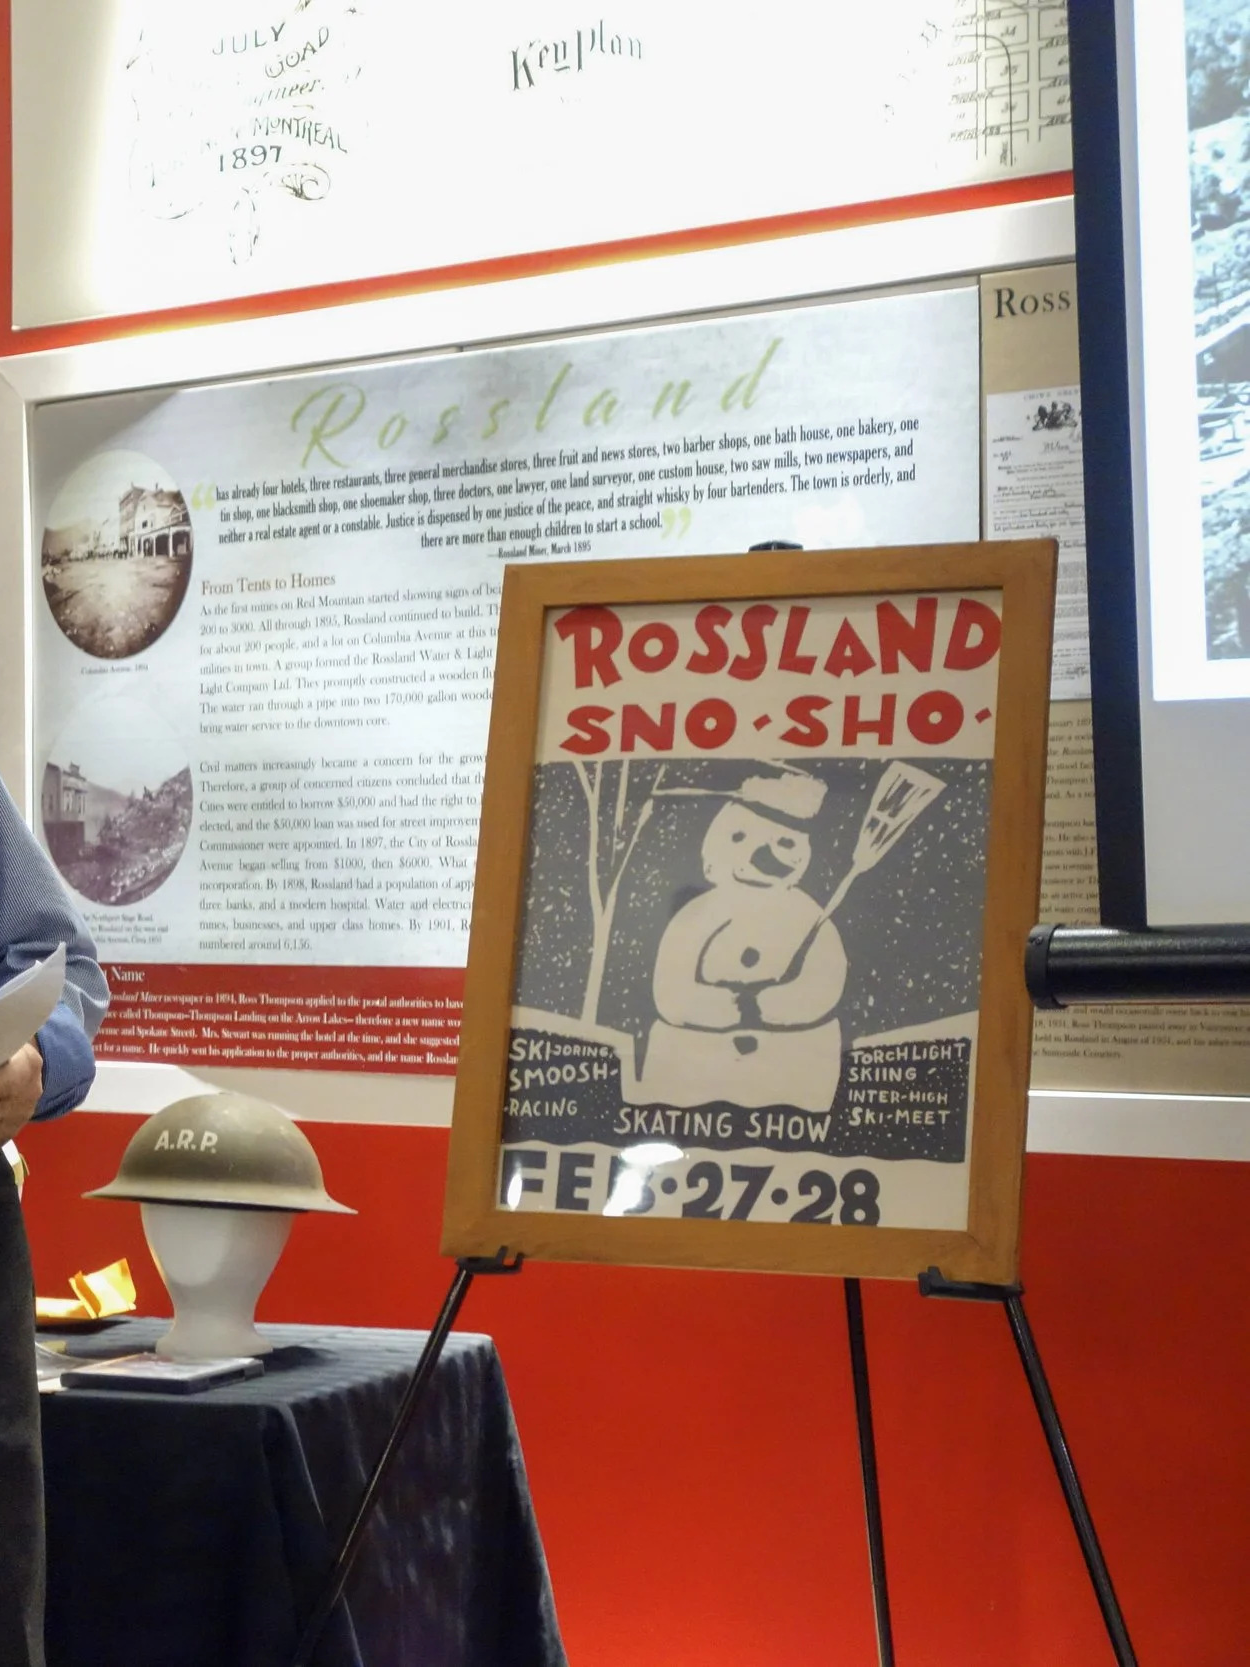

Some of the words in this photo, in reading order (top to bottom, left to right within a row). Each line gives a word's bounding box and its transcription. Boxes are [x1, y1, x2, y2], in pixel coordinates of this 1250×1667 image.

[212, 22, 286, 55] JULY
[253, 116, 347, 153] MONTREAL
[219, 145, 282, 172] 1897
[291, 338, 782, 469] Rossland
[215, 483, 229, 501] has
[230, 480, 260, 504] already
[261, 478, 279, 497] four
[280, 475, 308, 497] hotels,
[309, 473, 331, 492] three
[332, 469, 382, 492] restaurants,
[383, 465, 406, 485] three
[407, 462, 440, 487] general
[441, 456, 498, 479] merchandise
[499, 455, 530, 475] stores,
[532, 450, 557, 470] three
[558, 448, 579, 467] fruit
[580, 446, 599, 465] and
[600, 448, 625, 463] news
[627, 442, 660, 462] stores,
[661, 440, 681, 457] two
[682, 434, 715, 455] barber
[717, 431, 751, 456] shops,
[752, 434, 772, 448] one
[773, 426, 797, 446] bath
[799, 423, 833, 445] house,
[835, 426, 855, 440] one
[857, 416, 897, 442] bakery,
[899, 419, 919, 433] one
[219, 506, 231, 522] tin
[232, 502, 254, 526] shop,
[255, 505, 271, 519] one
[271, 496, 316, 517] blacksmith
[317, 494, 341, 518] shop,
[341, 497, 358, 511] one
[359, 488, 405, 509] shoemaker
[407, 485, 431, 509] shop,
[432, 483, 456, 502] three
[457, 479, 494, 502] doctors,
[495, 483, 513, 496] one
[514, 474, 547, 499] lawyer,
[549, 478, 567, 491] one
[568, 470, 589, 490] land
[591, 471, 635, 492] surveyor,
[637, 469, 655, 483] one
[657, 463, 693, 481] custom
[695, 457, 727, 480] house,
[729, 457, 749, 475] two
[750, 459, 771, 473] saw
[773, 451, 801, 473] mills,
[803, 450, 823, 468] two
[825, 447, 891, 470] newspapers,
[893, 440, 913, 459] and
[218, 525, 246, 544] neither
[247, 529, 253, 542] a
[254, 522, 271, 541] real
[271, 522, 296, 540] estate
[297, 520, 320, 542] agent
[321, 522, 332, 535] or
[333, 521, 339, 534] a
[340, 512, 383, 533] constable.
[385, 509, 415, 529] Justice
[416, 510, 425, 526] is
[426, 504, 470, 530] dispensed
[471, 503, 483, 526] by
[485, 507, 502, 520] one
[503, 501, 534, 523] justice
[535, 497, 546, 516] of
[547, 496, 562, 515] the
[564, 498, 594, 518] peace,
[596, 491, 614, 510] and
[616, 488, 653, 513] straight
[655, 484, 690, 509] whisky
[692, 483, 705, 506] by
[706, 481, 727, 500] four
[729, 476, 787, 498] bartenders.
[789, 474, 810, 493] The
[812, 473, 838, 491] town
[840, 472, 850, 488] is
[851, 466, 893, 492] orderly,
[895, 464, 916, 483] and
[419, 530, 443, 549] there
[445, 534, 459, 547] are
[461, 532, 485, 546] more
[486, 525, 507, 544] than
[508, 522, 542, 547] enough
[543, 519, 582, 539] children
[583, 520, 594, 536] to
[595, 518, 618, 535] start
[620, 520, 627, 533] a
[628, 512, 663, 532] school.
[200, 579, 233, 596] From
[235, 577, 271, 593] Tents
[274, 577, 287, 591] to
[290, 573, 336, 590] Homes
[554, 597, 1002, 690] ROSSLAND
[111, 965, 146, 983] Name
[848, 1067, 917, 1082] SKIING
[155, 1129, 218, 1154] A.R.P.
[614, 1107, 733, 1138] SKATING
[744, 1112, 831, 1142] SHOW
